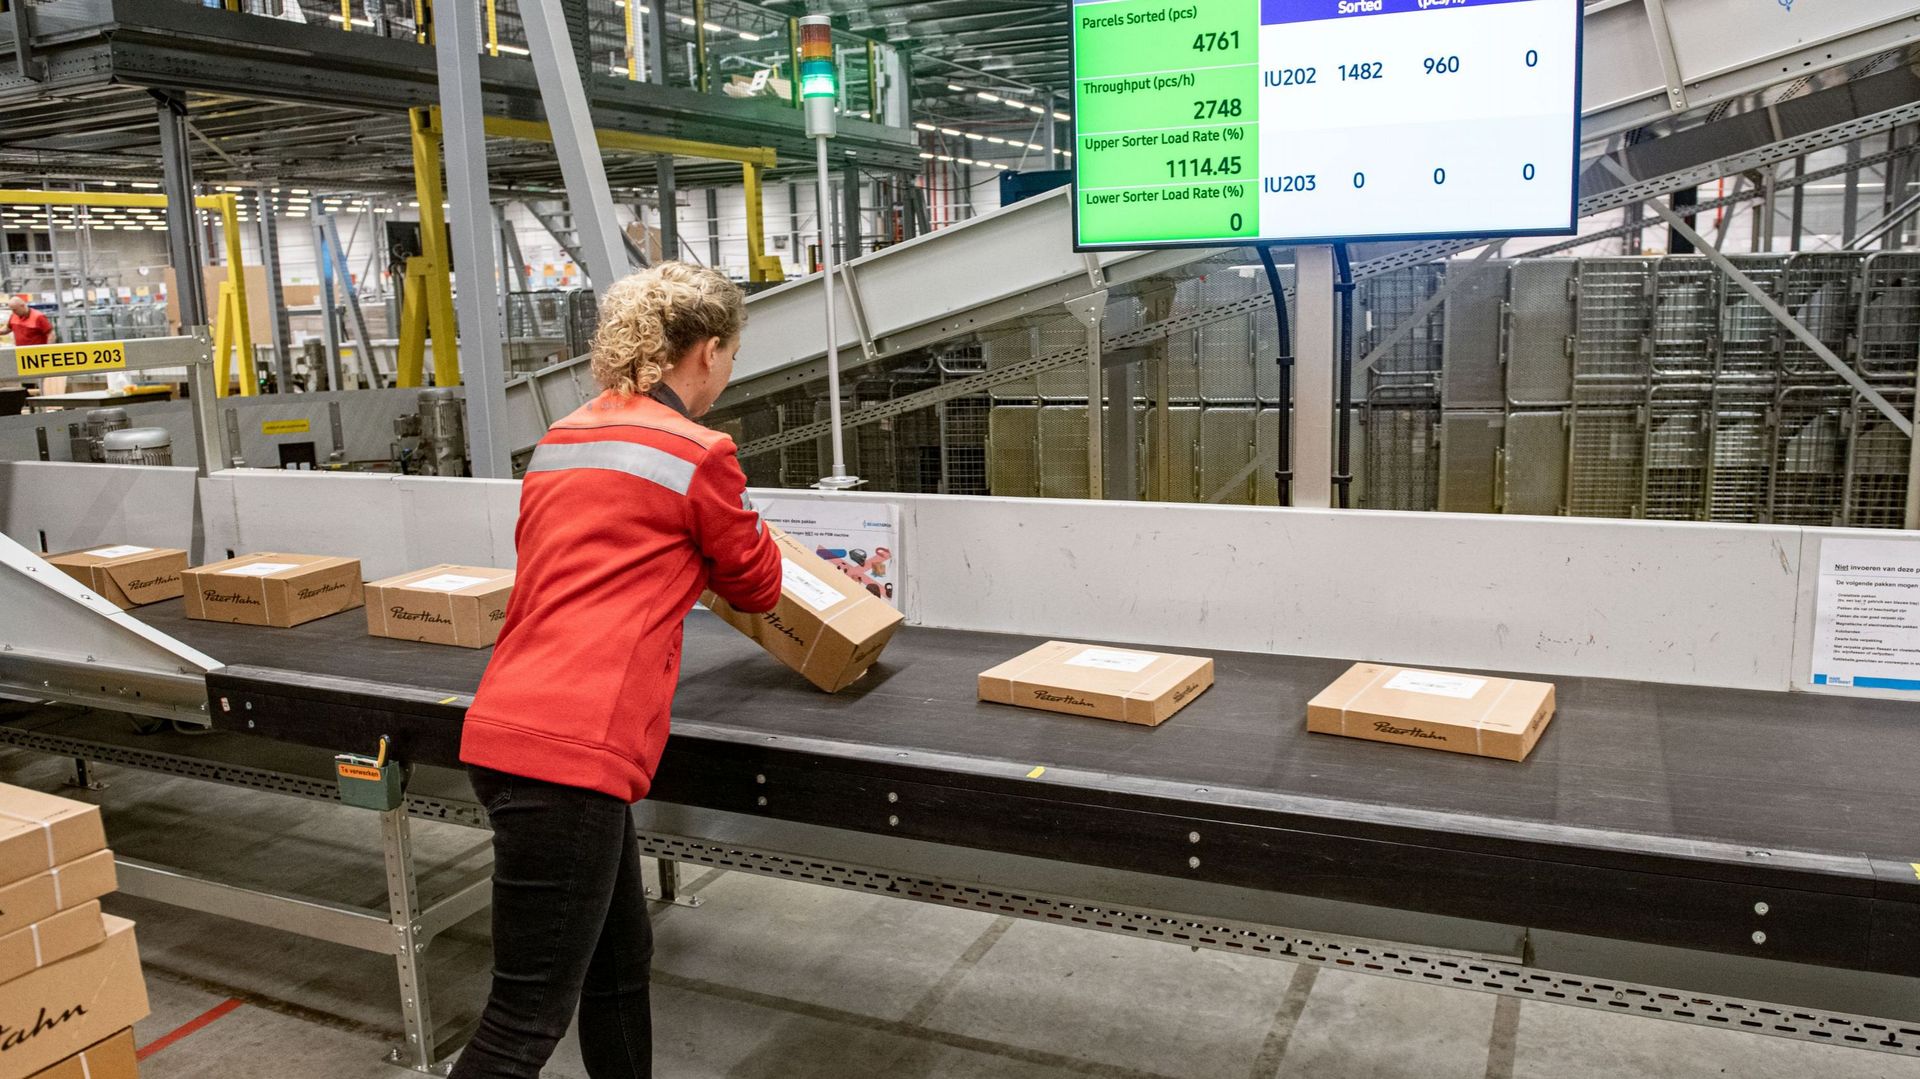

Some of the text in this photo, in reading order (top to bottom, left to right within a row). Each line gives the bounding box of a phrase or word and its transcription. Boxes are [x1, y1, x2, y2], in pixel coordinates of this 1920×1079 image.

[1082, 5, 1198, 29] Parcels Sorted (pcs)
[1338, 0, 1382, 14] Sorted
[1192, 30, 1239, 52] 4761
[1264, 49, 1538, 87] IU202 1482 960 0
[1083, 73, 1195, 94] Throughput (pcs/h)
[1193, 98, 1242, 120] 2748
[1085, 127, 1244, 152] Upper Sorter Load Rate (%)
[1166, 156, 1242, 178] 1114.45
[1264, 163, 1535, 193] IU203 0 0 0
[1086, 184, 1244, 205] Lower Sorter Load Rate (%)
[1229, 212, 1243, 232] 0
[21, 349, 122, 369] INFEED 203
[0, 1004, 88, 1051] ahn
